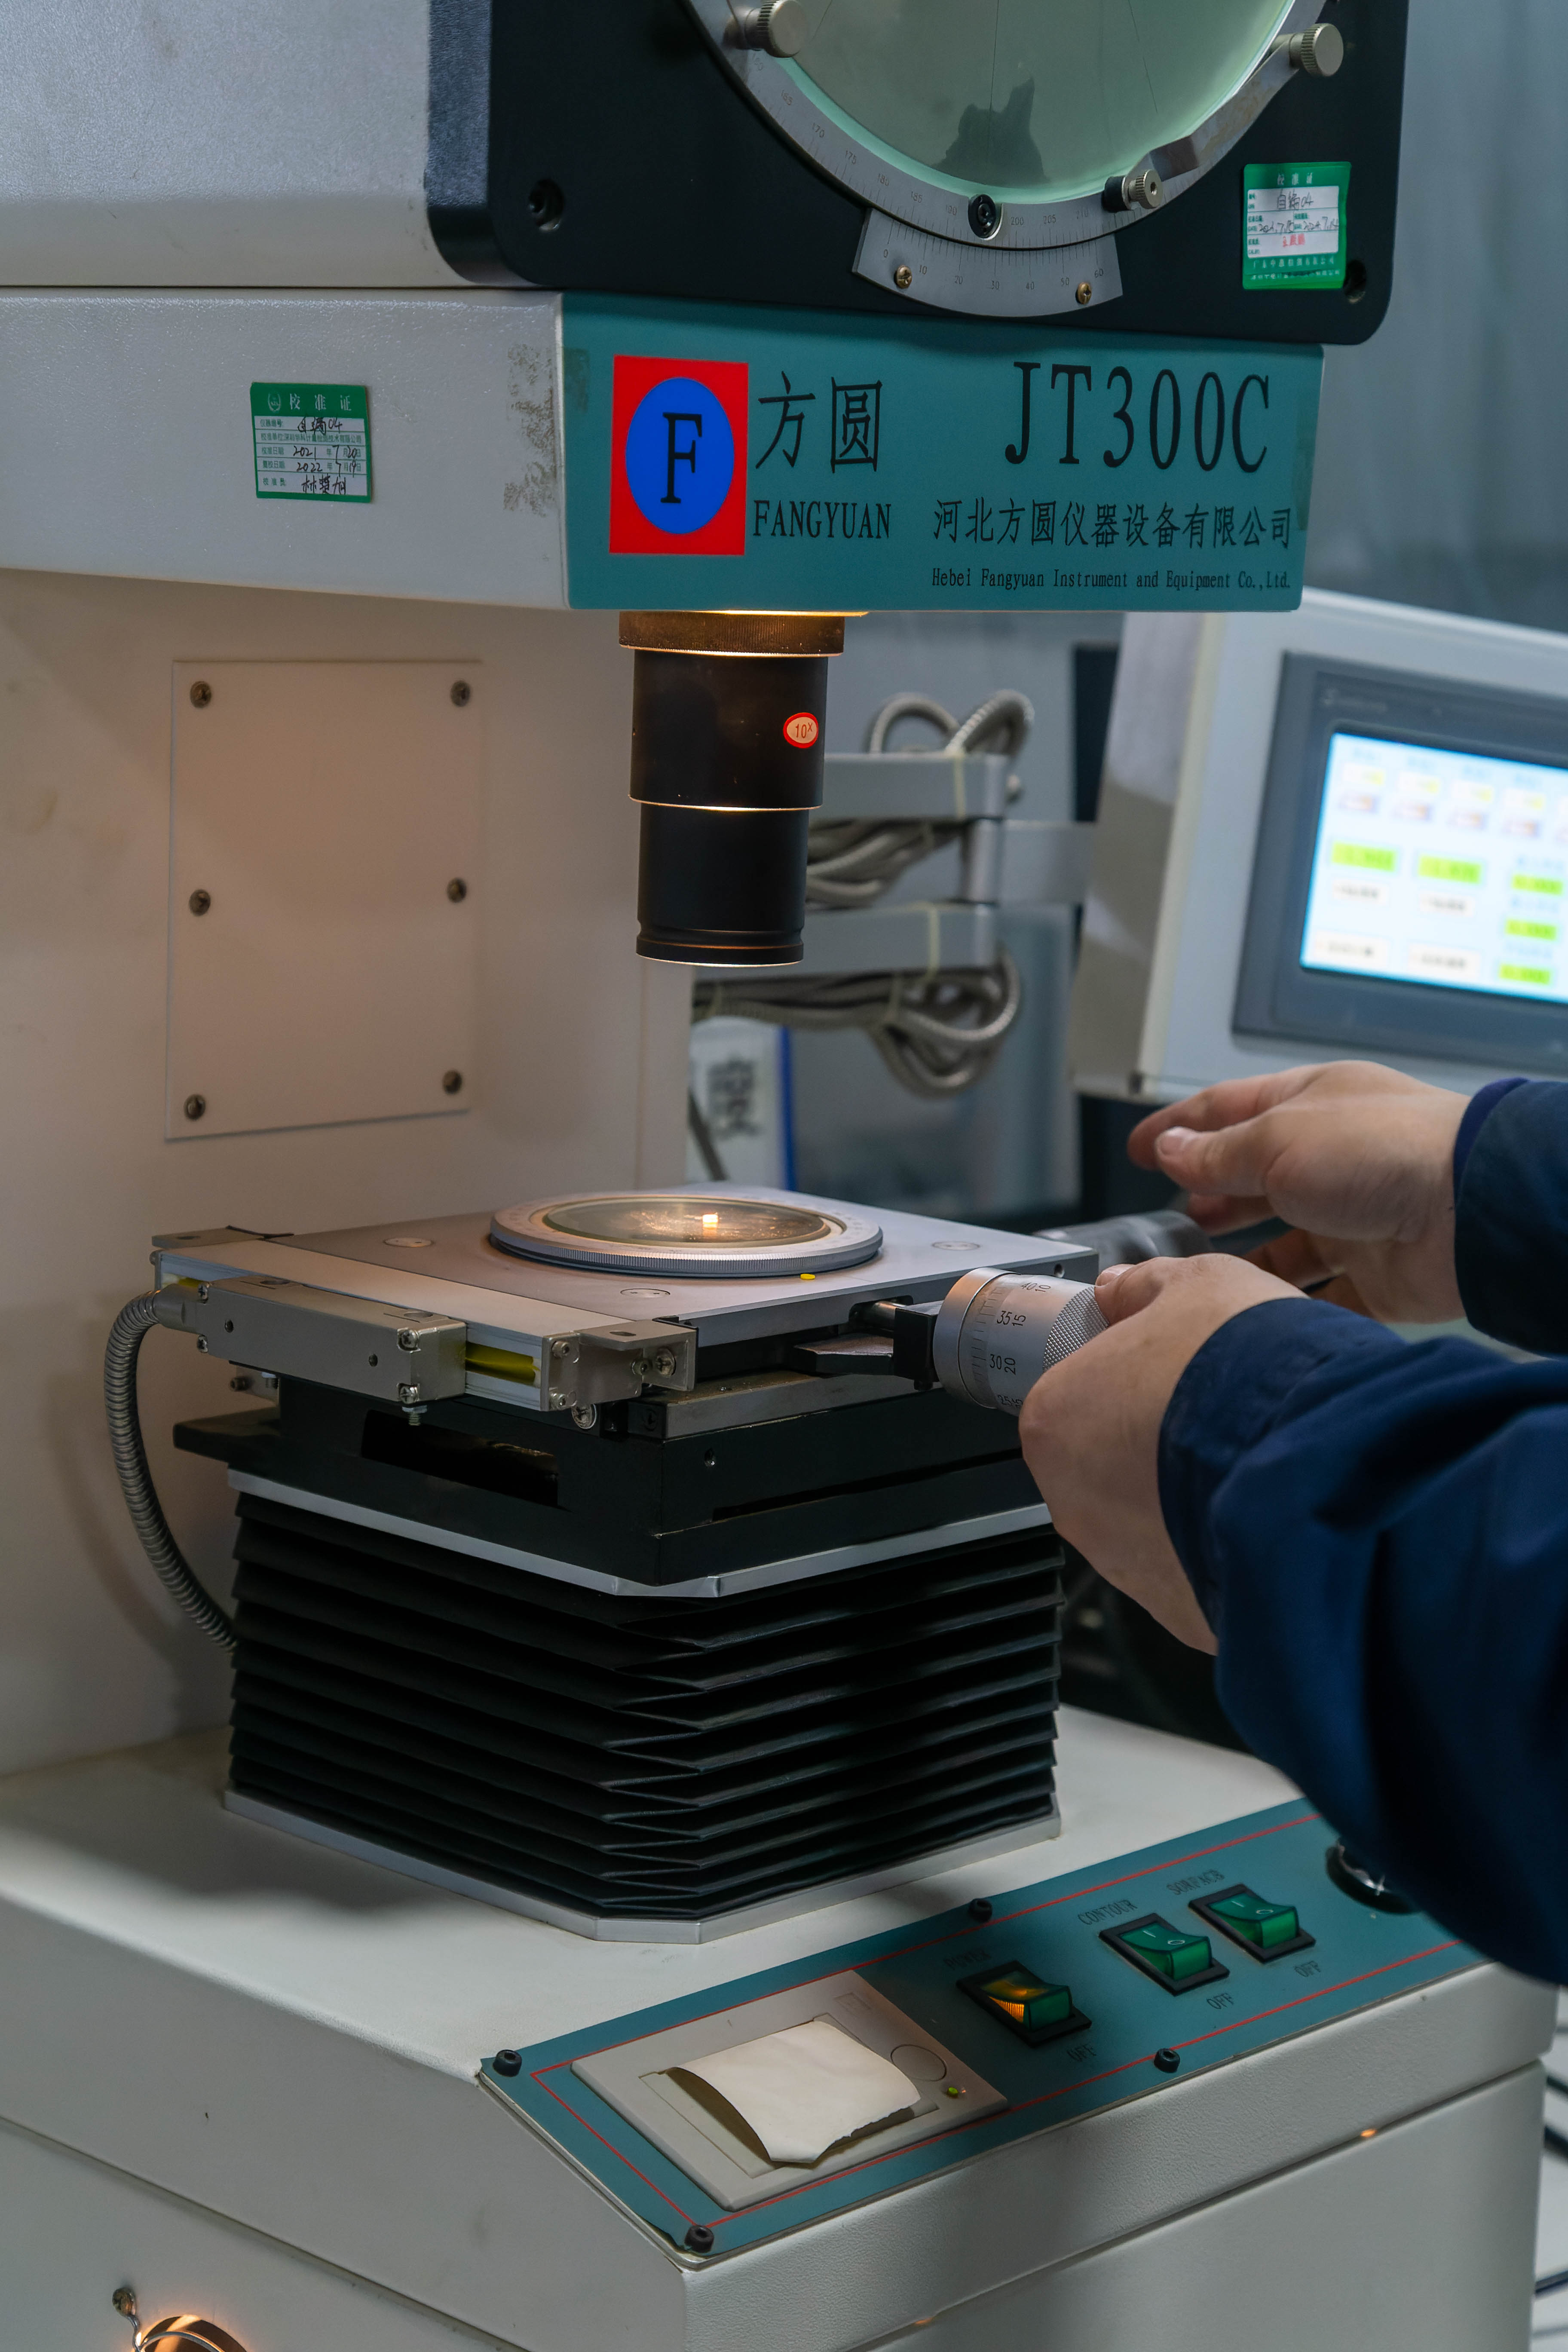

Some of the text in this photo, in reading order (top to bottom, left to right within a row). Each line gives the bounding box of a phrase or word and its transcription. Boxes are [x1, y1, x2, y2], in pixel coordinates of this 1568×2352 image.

[812, 122, 825, 138] 170
[845, 150, 857, 165] 175
[878, 173, 889, 186] 180
[911, 191, 923, 203] 185
[946, 204, 957, 216] 190
[1011, 216, 1024, 226] 200
[1043, 214, 1057, 225] 205
[884, 249, 888, 258] 0
[919, 264, 928, 275] 10
[1094, 268, 1104, 278] 60
[954, 276, 963, 285] 20
[991, 281, 1000, 290] 30
[1026, 282, 1035, 290] 40
[1061, 277, 1070, 286] 50
[289, 393, 352, 411] 校准证
[755, 371, 883, 474] 方圆
[1004, 361, 1271, 474] JT300C
[660, 412, 702, 504] F
[296, 462, 323, 472] 2022
[753, 499, 891, 539] FANGYUAN
[934, 496, 1291, 548] 河北方圆仪器设备有限公司
[932, 568, 971, 587] Hebei
[981, 568, 1044, 591] Fangyuan
[1053, 569, 1127, 588] Instrument
[1136, 570, 1158, 588] and
[1166, 570, 1230, 591] Equipment
[1020, 1283, 1037, 1291] 40
[1035, 1284, 1051, 1293] 10
[996, 1310, 1013, 1326] 35
[1011, 1314, 1026, 1327] 15
[989, 1354, 1002, 1370] 30
[1004, 1357, 1016, 1375] 20
[1078, 1899, 1138, 1925] CONTOUR
[1207, 1992, 1234, 2009] OFF
